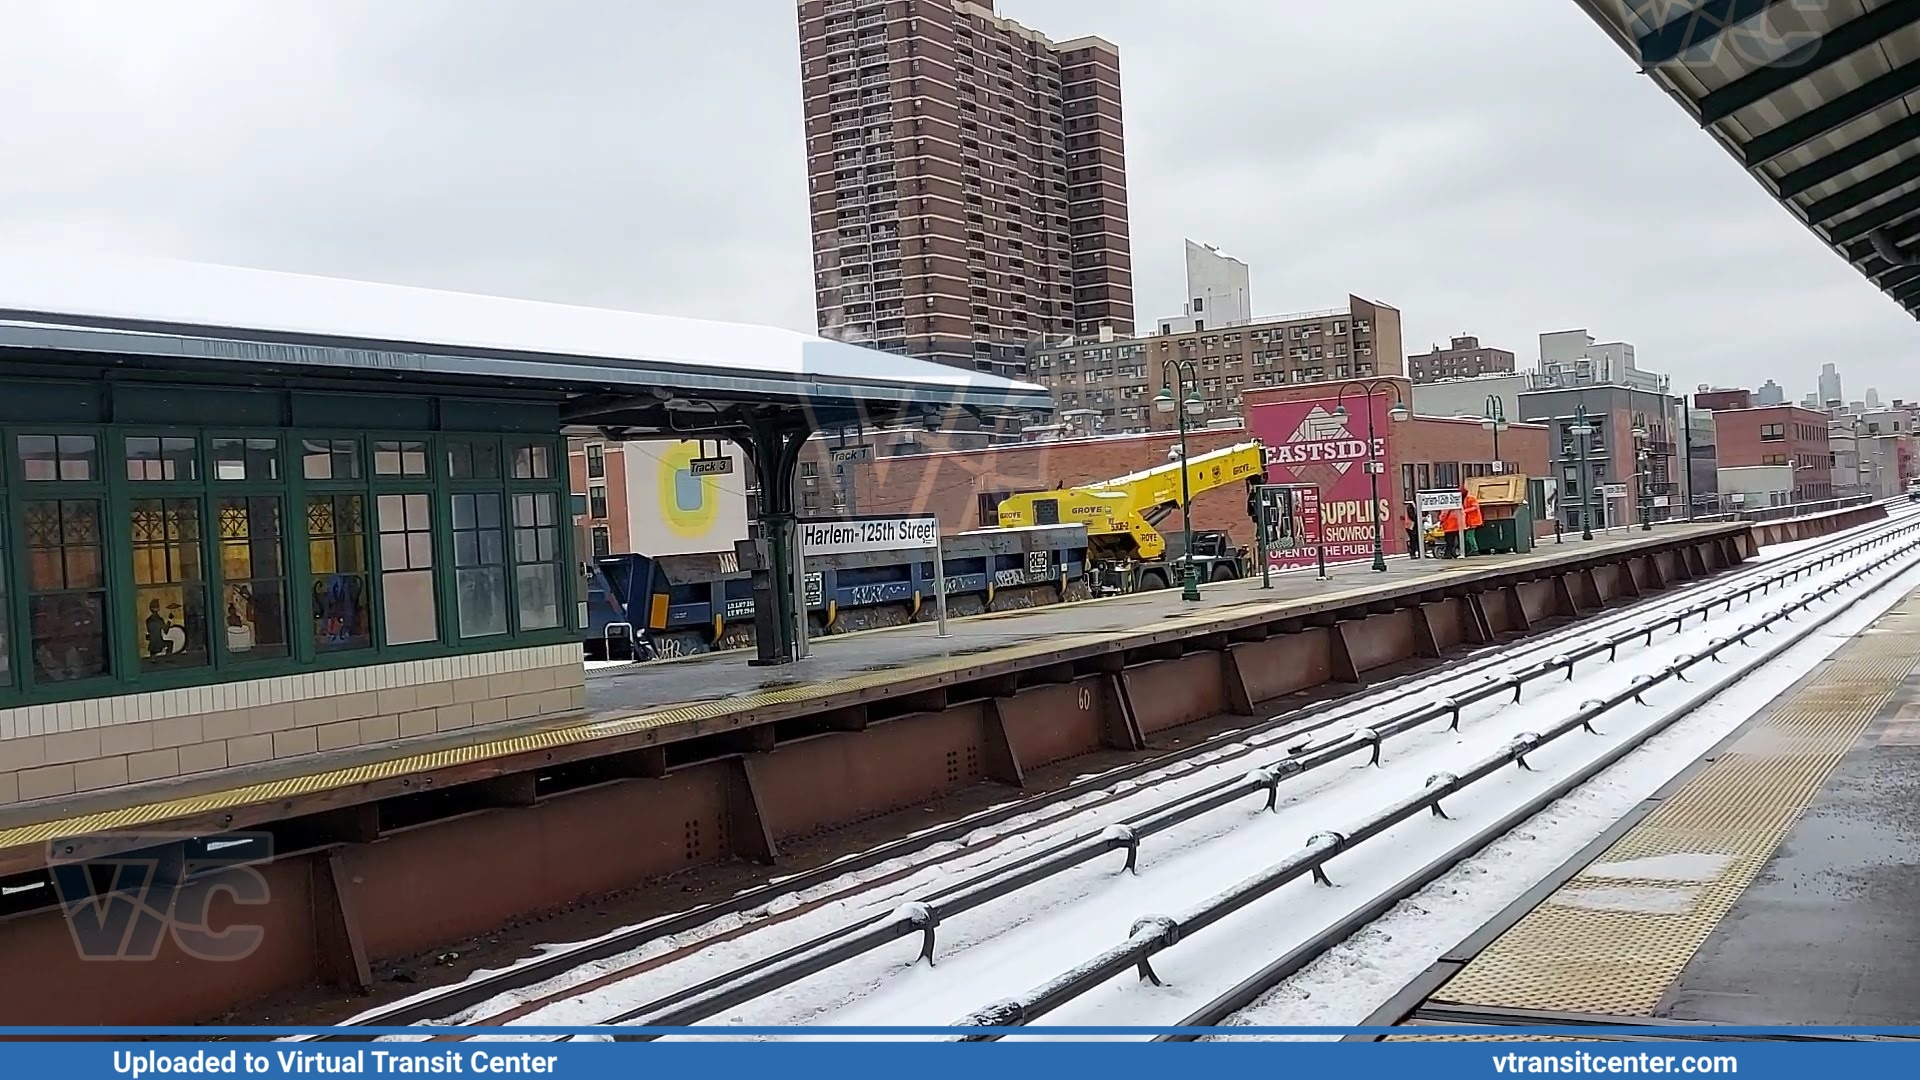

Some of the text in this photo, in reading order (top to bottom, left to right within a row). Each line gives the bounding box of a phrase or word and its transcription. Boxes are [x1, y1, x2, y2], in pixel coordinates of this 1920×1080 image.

[829, 448, 867, 462] Track 1
[1266, 438, 1385, 465] EASTSIDE
[690, 460, 726, 473] Track 3
[1000, 511, 1021, 519] GROVE
[1071, 506, 1102, 514] GROVE
[804, 520, 936, 546] Harlem-125th Street
[1269, 547, 1300, 559] OPEN
[1301, 546, 1317, 557] TO
[1342, 543, 1376, 556] PUBLI
[1078, 687, 1090, 710] 60
